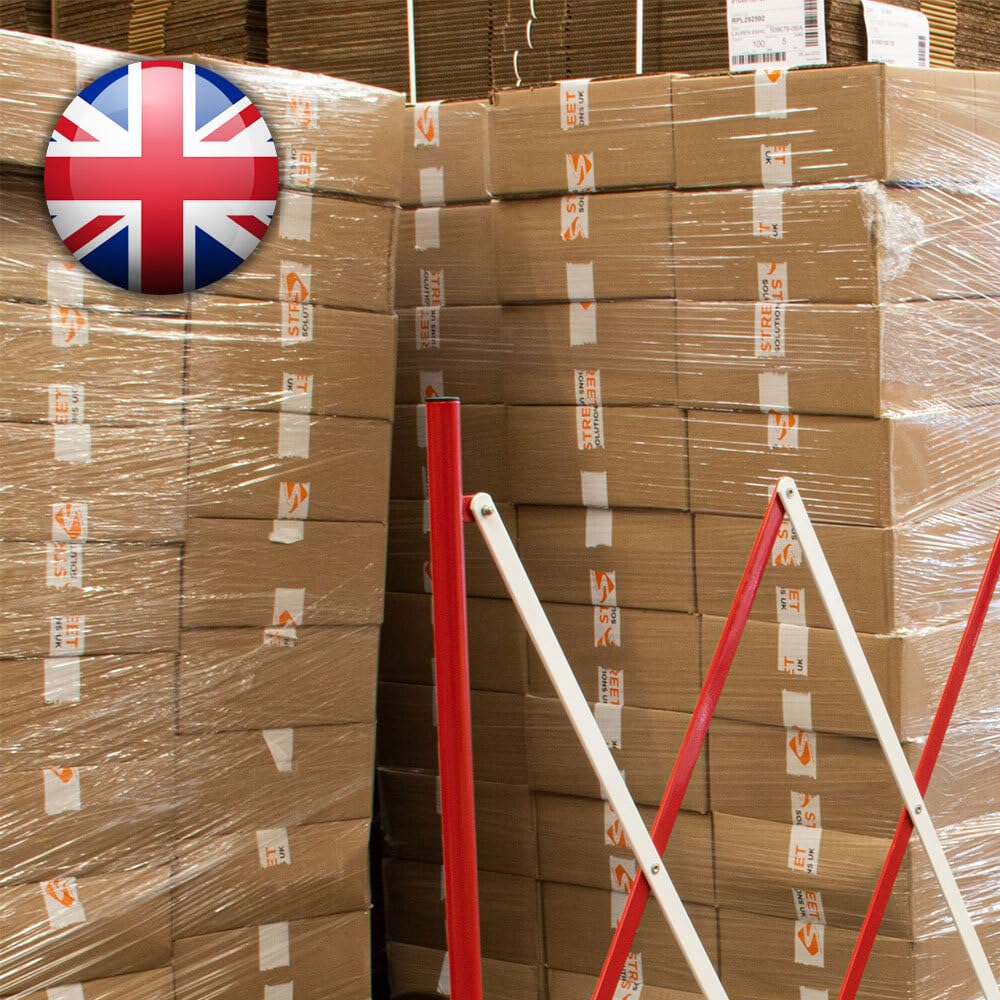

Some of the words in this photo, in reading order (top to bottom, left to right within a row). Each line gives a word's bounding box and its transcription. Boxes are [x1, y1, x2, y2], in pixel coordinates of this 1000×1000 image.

[577, 90, 585, 104] UK
[566, 91, 577, 125] EET
[772, 223, 778, 237] UK
[287, 378, 294, 391] UK
[780, 598, 787, 611] UK
[789, 588, 800, 613] ET
[56, 634, 62, 648] UK
[797, 658, 803, 672] UK
[278, 846, 286, 859] UK
[807, 847, 815, 860] UK
[805, 890, 820, 921] EET
